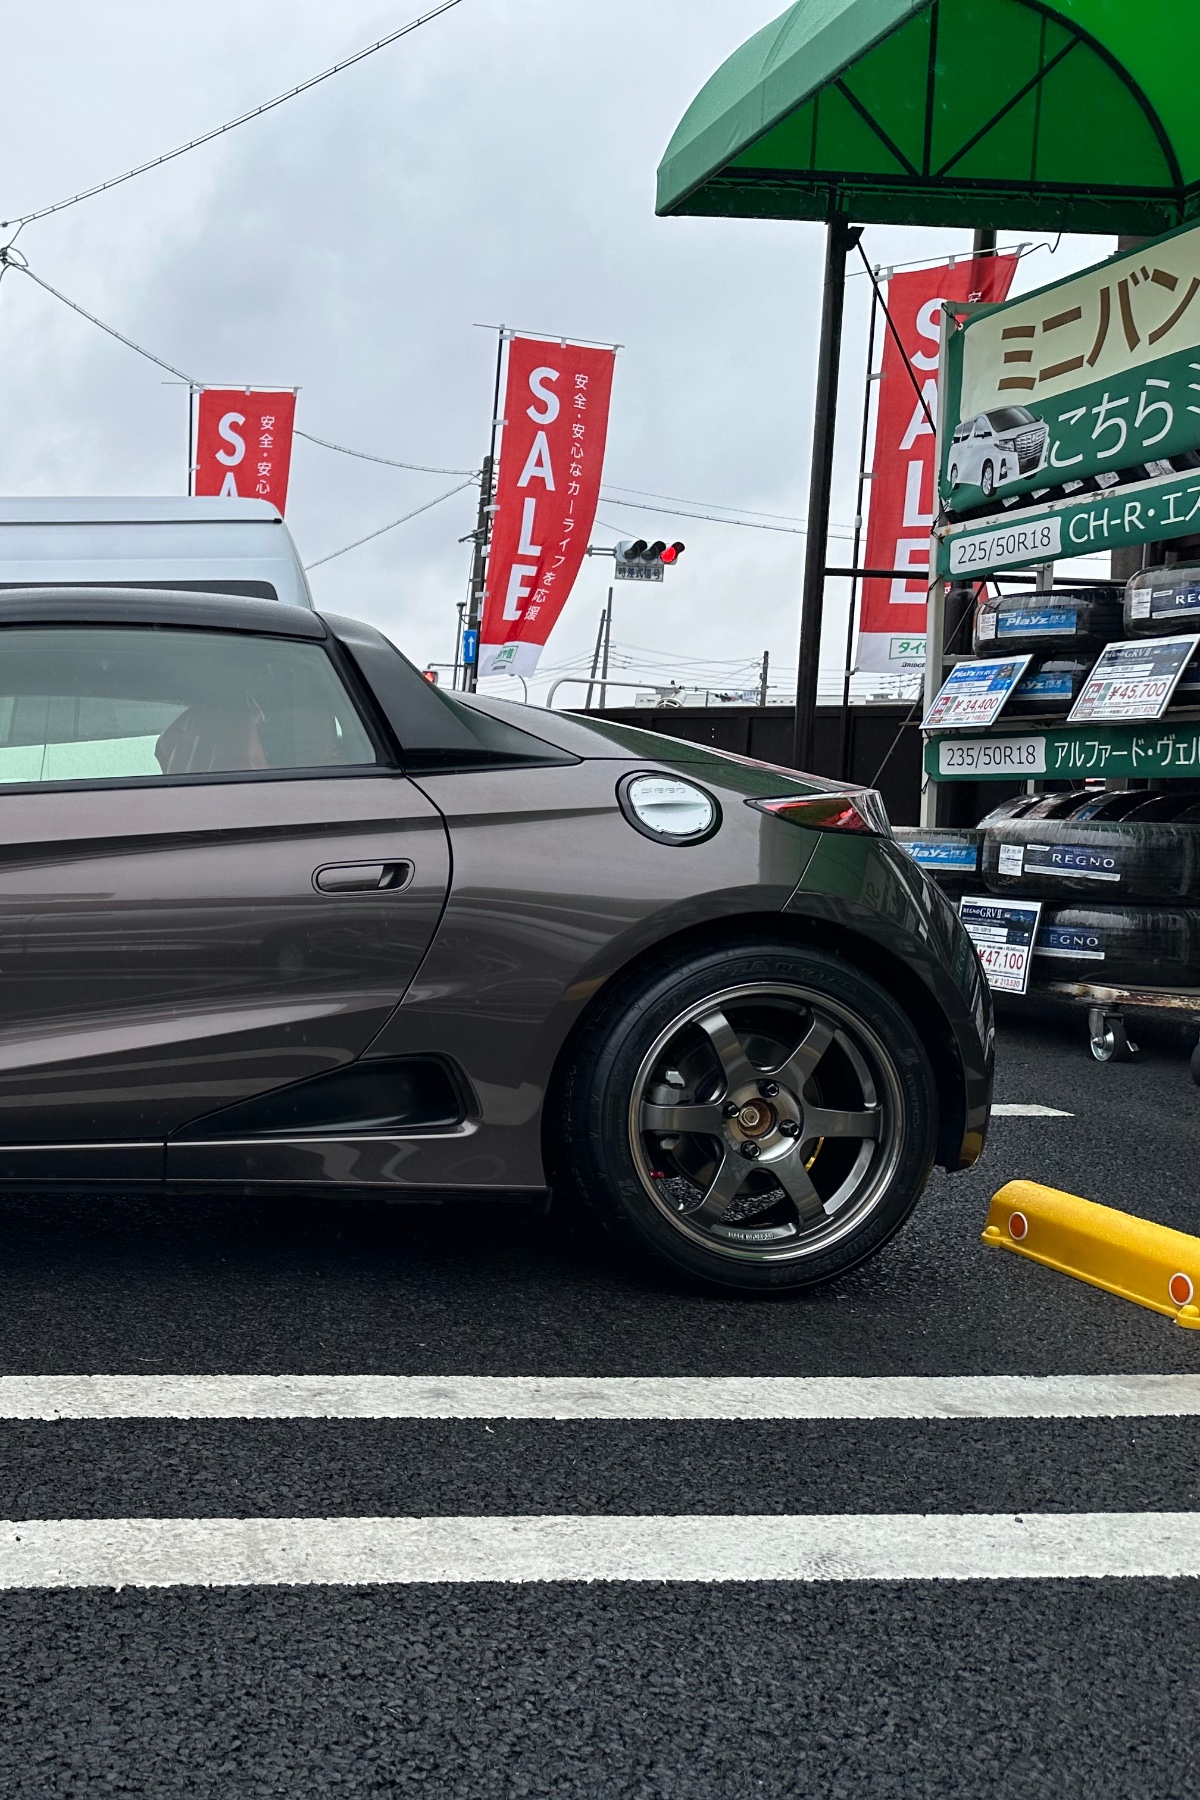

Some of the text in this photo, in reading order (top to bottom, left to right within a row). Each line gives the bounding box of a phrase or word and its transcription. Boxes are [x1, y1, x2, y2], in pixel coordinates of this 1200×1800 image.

[998, 265, 1200, 392] ミニバン
[1050, 362, 1200, 468] こちら
[502, 367, 560, 621] SALE
[957, 526, 1051, 565] 225/50R18
[1006, 616, 1049, 627] Playz
[898, 641, 927, 655] タイ
[1108, 682, 1167, 701] ¥45,700
[947, 744, 1036, 769] 235/50R18
[1052, 853, 1115, 868] REGNO
[1049, 934, 1099, 947] EGNO
